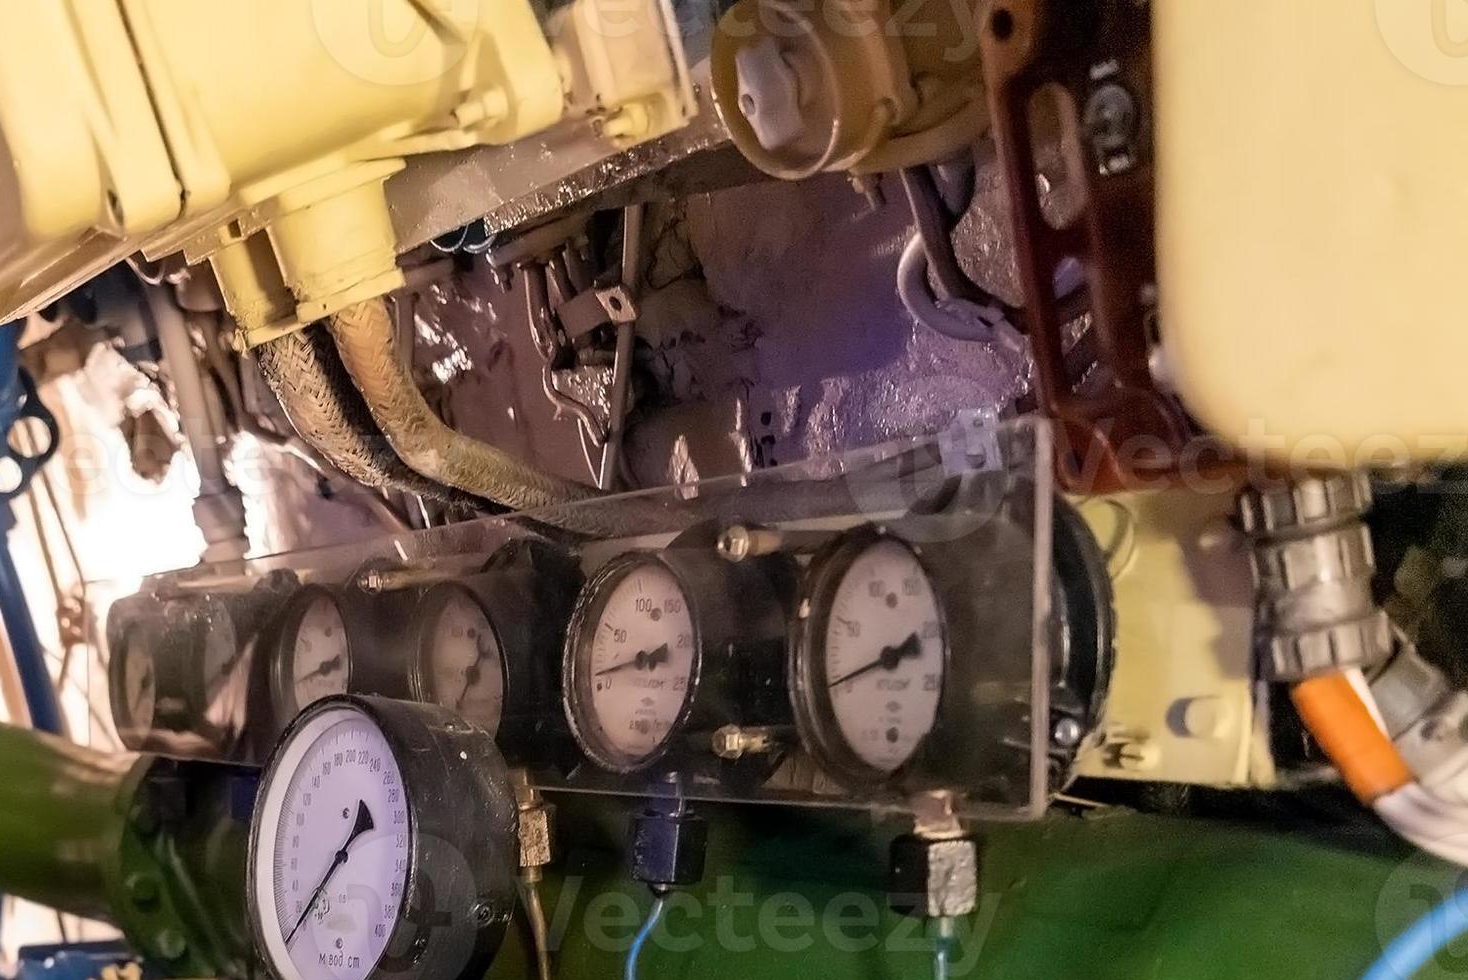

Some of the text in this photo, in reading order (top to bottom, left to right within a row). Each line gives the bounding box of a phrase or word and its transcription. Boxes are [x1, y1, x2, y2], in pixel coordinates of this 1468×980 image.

[635, 599, 653, 612] 100
[613, 629, 627, 643] 50
[345, 749, 356, 763] 200
[358, 750, 369, 765] 220
[369, 758, 381, 773] 240
